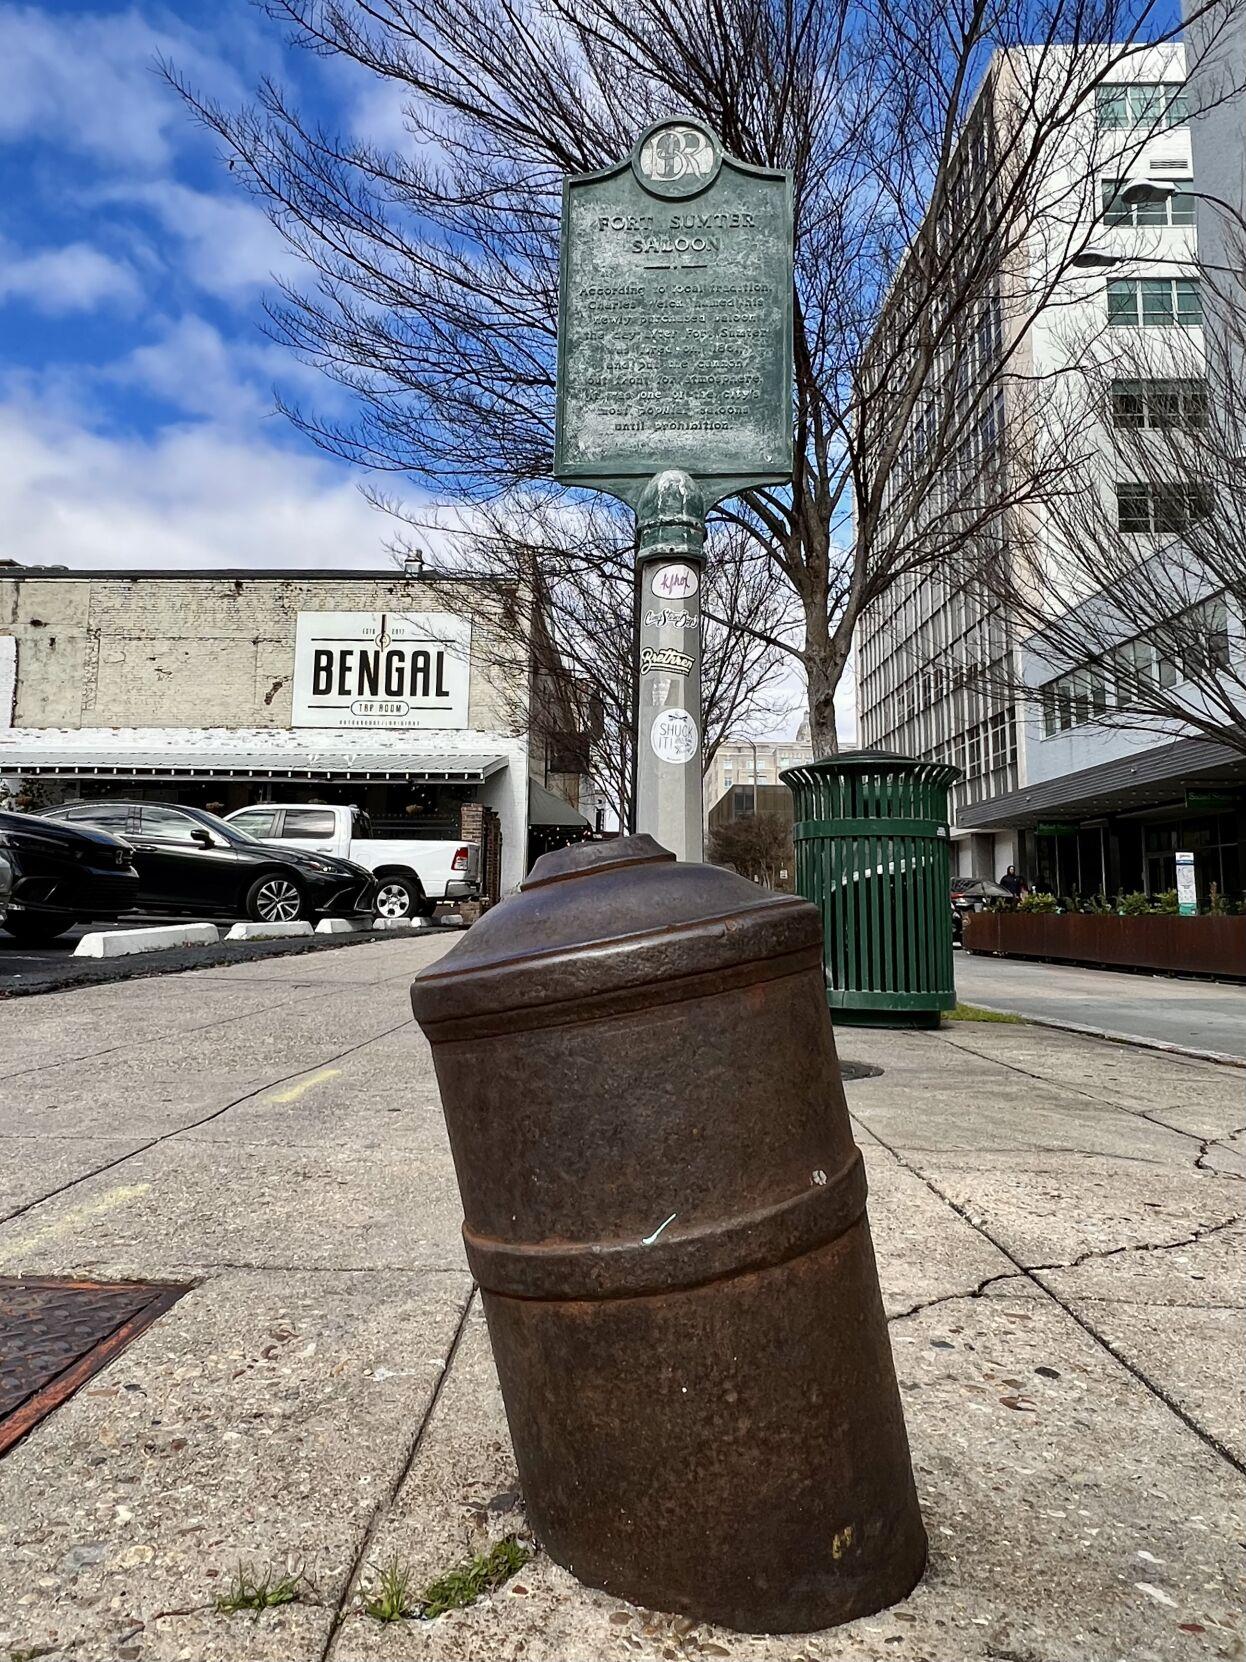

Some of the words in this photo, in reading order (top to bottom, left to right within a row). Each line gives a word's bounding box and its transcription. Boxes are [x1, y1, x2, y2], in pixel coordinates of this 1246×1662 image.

[599, 216, 654, 232] FORT
[669, 213, 756, 230] SUMTER
[631, 236, 722, 254] SALOON
[579, 286, 646, 297] According
[720, 326, 768, 338] Sumter
[640, 389, 662, 400] one
[614, 420, 646, 432] until
[641, 647, 695, 676] Brethren
[312, 649, 450, 697] BENGAL
[358, 703, 374, 713] TAP
[378, 703, 402, 713] ROOM
[659, 722, 694, 738] SHUCK
